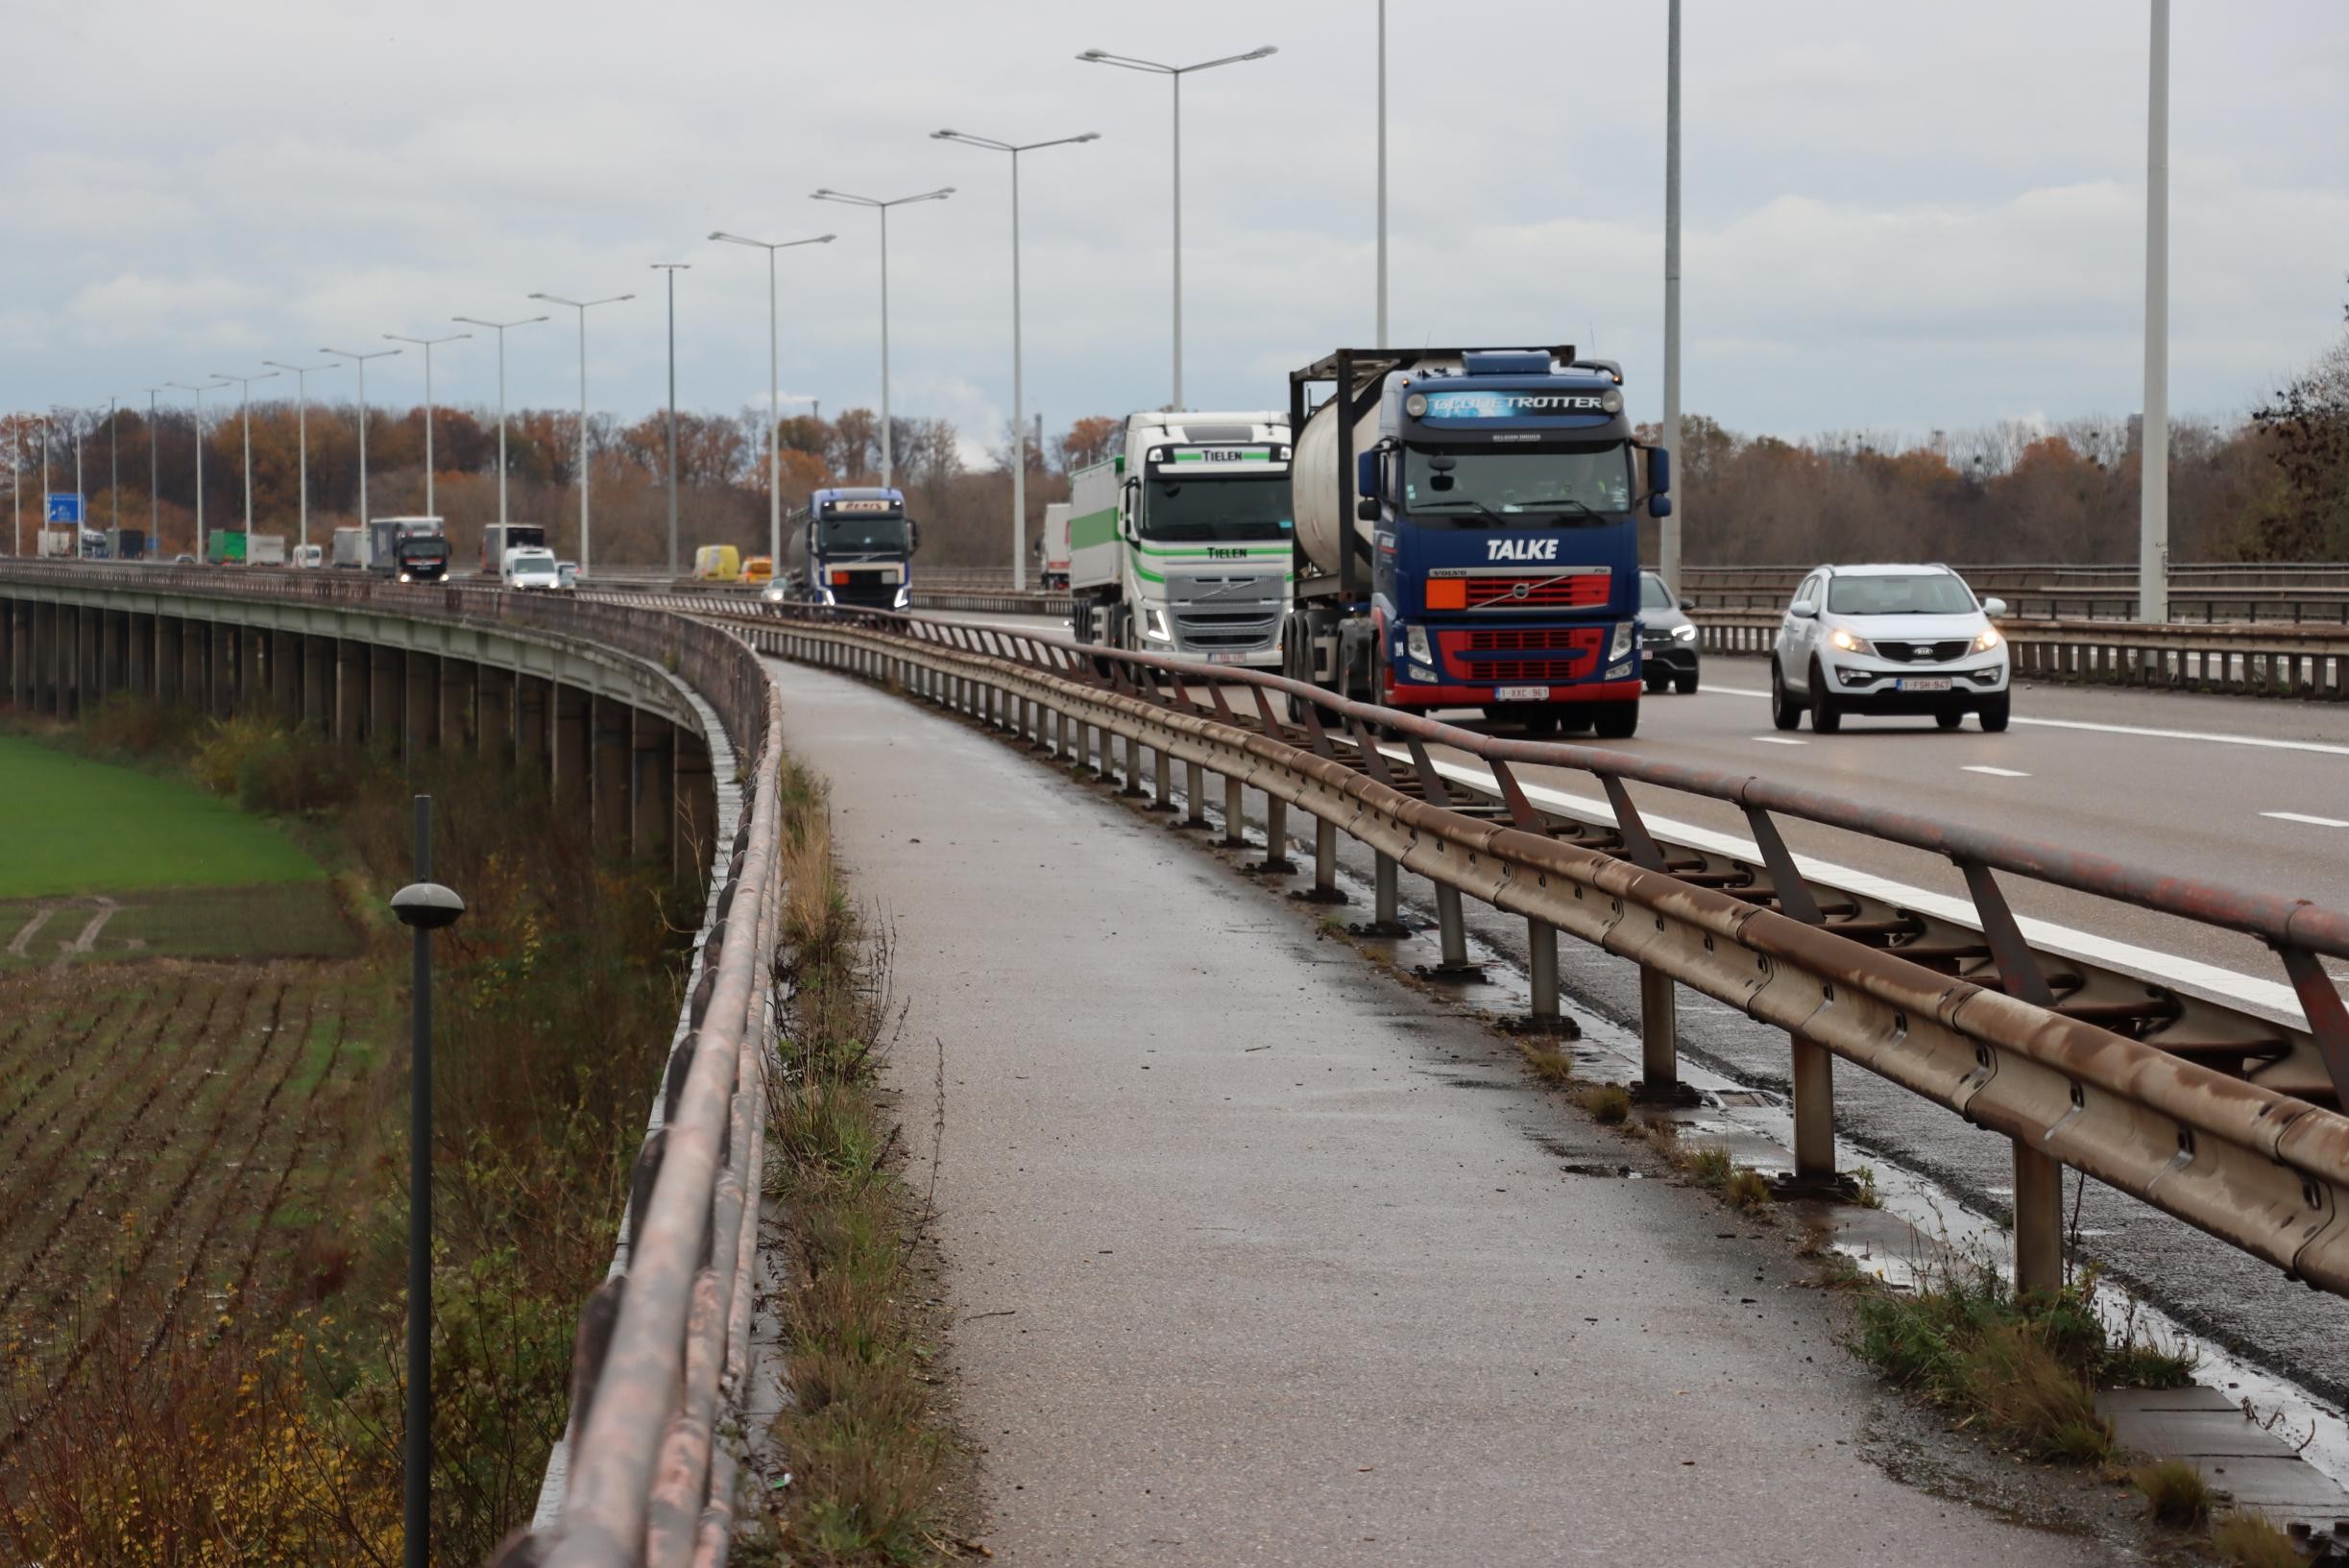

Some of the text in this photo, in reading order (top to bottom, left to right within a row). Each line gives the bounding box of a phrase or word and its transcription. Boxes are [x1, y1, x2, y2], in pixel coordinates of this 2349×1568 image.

[1201, 449, 1243, 462] TIELEN
[1206, 547, 1247, 559] TIELEN
[1487, 539, 1560, 561] TALKE
